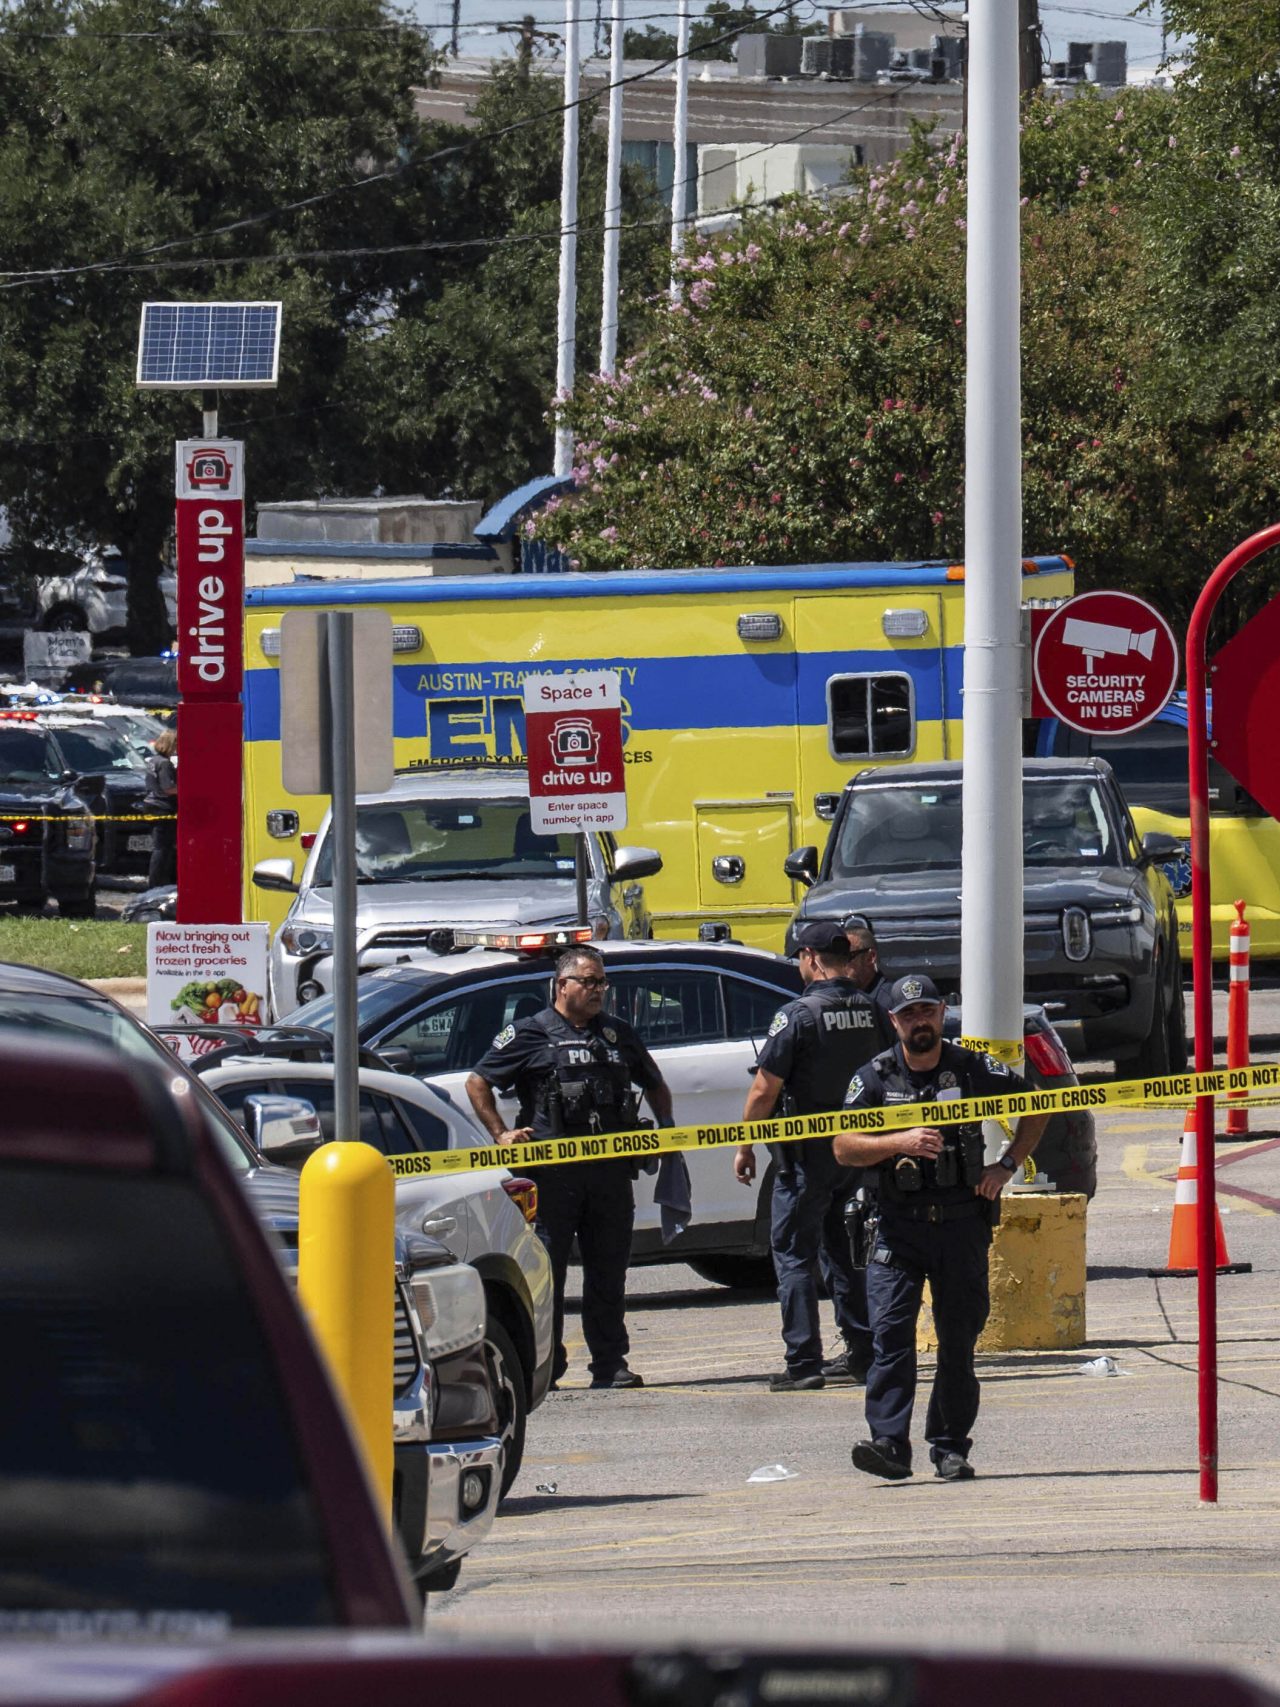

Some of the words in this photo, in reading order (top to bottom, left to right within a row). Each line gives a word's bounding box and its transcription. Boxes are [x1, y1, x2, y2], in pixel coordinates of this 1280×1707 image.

[197, 509, 233, 563] up
[189, 575, 226, 683] drive
[1066, 675, 1146, 687] SECURITY
[540, 686, 593, 704] Space
[598, 684, 607, 698] 1
[1067, 690, 1145, 703] CAMERAS
[1080, 706, 1098, 718] IN
[1101, 705, 1133, 718] USE
[542, 770, 585, 786] drive
[589, 770, 612, 786] up
[548, 802, 574, 812] Enter
[577, 801, 608, 814] space
[542, 814, 581, 825] number
[583, 815, 593, 824] in
[596, 813, 614, 825] app
[156, 931, 181, 941] Now
[184, 931, 228, 943] bringing
[231, 932, 250, 941] out
[156, 944, 189, 954] select
[192, 944, 221, 954] fresh
[223, 944, 231, 953] &
[156, 956, 191, 966] frozen
[194, 956, 247, 967] groceries
[823, 1010, 874, 1031] POLICE
[1143, 1079, 1192, 1098] POLICE
[1196, 1075, 1225, 1093] LINE
[1229, 1072, 1248, 1088] DO
[1252, 1068, 1280, 1085] NOT
[921, 1103, 970, 1123] POLICE
[974, 1099, 1004, 1116] LINE
[1008, 1096, 1027, 1114] DO
[1032, 1093, 1059, 1110] NOT
[1063, 1088, 1107, 1106] CROSS
[697, 1126, 746, 1146] POLICE
[750, 1122, 780, 1140] LINE
[784, 1119, 804, 1136] DO
[808, 1116, 836, 1134] NOT
[840, 1111, 885, 1130] CROSS
[470, 1148, 518, 1168] POLICE
[523, 1144, 553, 1162] LINE
[557, 1142, 577, 1158] DO
[581, 1140, 608, 1157] NOT
[613, 1133, 660, 1152] CROSS
